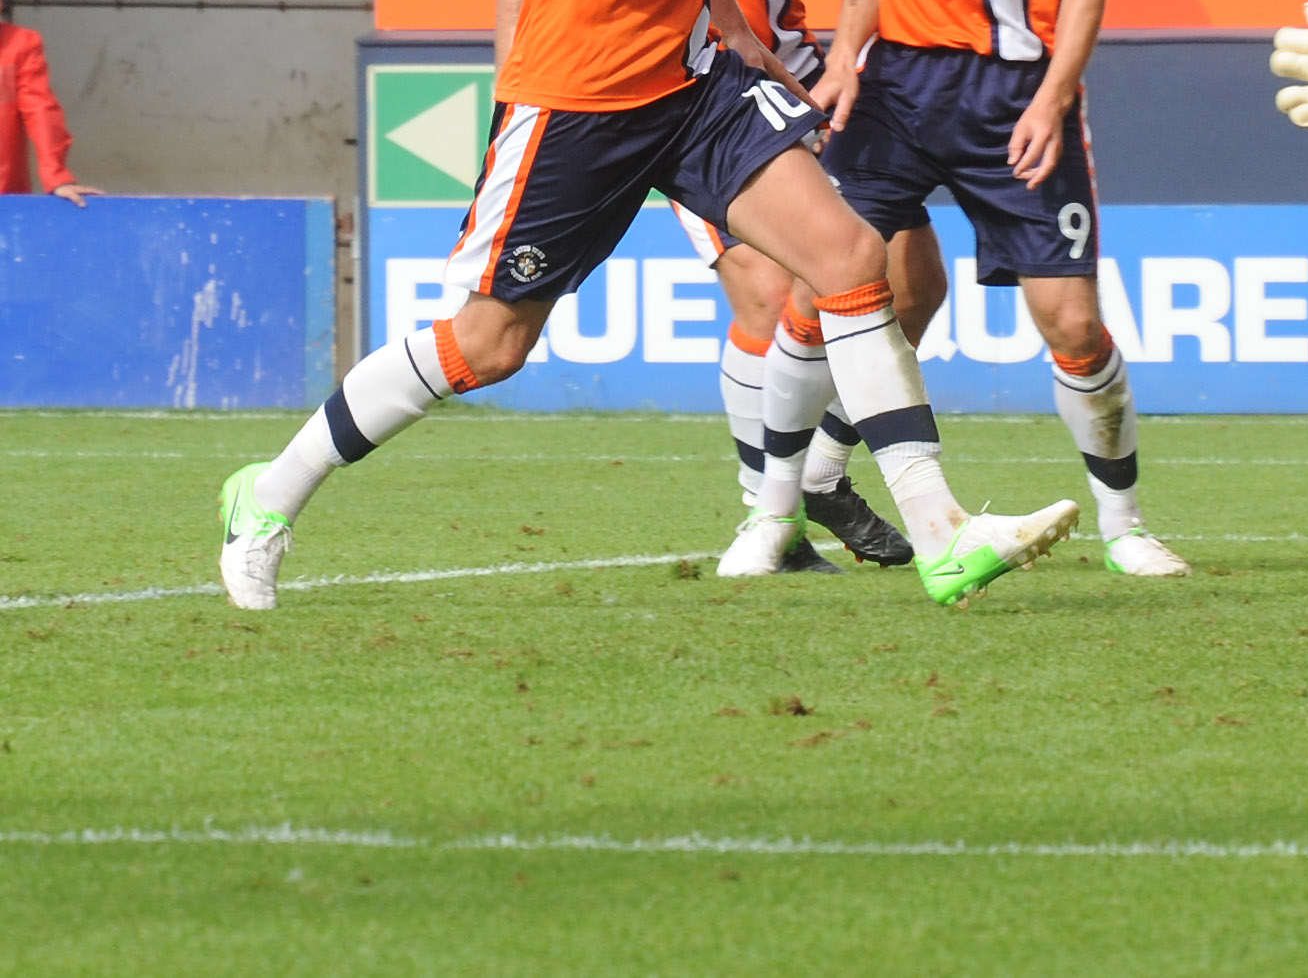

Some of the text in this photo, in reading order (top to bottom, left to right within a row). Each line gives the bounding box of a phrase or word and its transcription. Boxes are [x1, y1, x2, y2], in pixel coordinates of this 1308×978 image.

[741, 79, 812, 132] 10
[1057, 202, 1091, 260] 9
[385, 257, 720, 364] BUE
